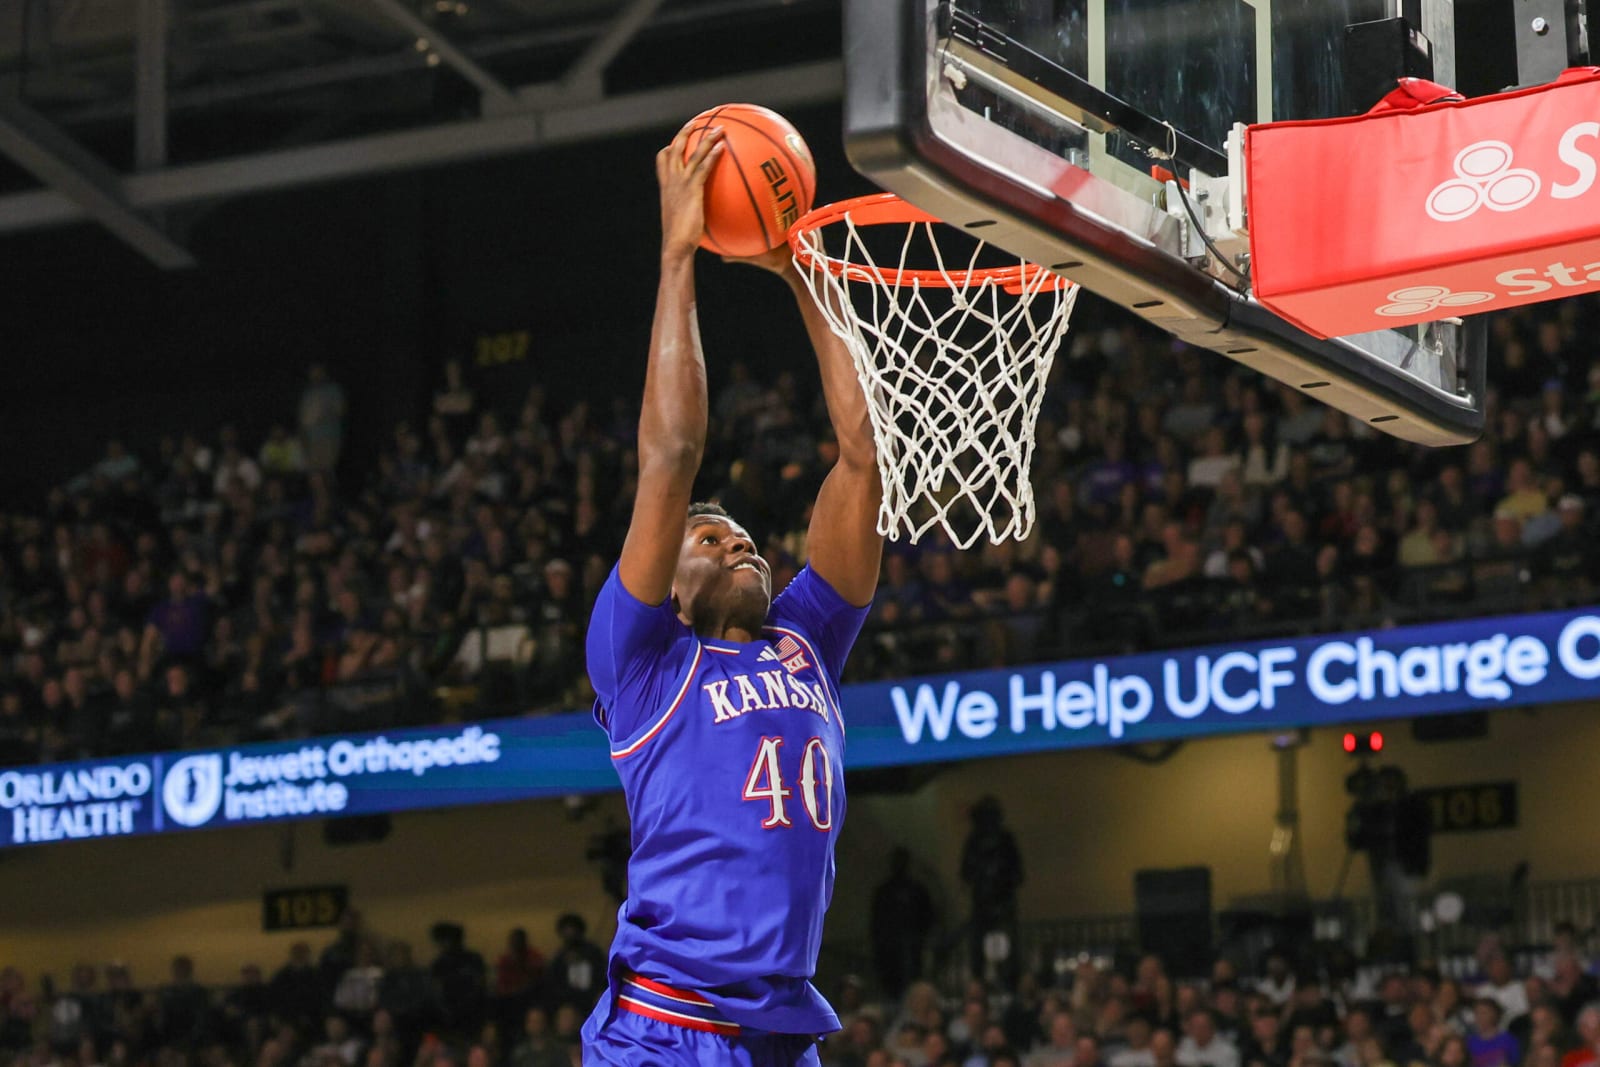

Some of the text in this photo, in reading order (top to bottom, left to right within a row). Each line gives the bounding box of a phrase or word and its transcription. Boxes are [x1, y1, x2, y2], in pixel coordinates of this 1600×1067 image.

[761, 156, 799, 232] ELITE
[891, 681, 998, 744] We
[1009, 664, 1153, 738] Help
[1163, 647, 1297, 719] UCF
[1306, 633, 1549, 704] Charge
[0, 762, 151, 808] ORLANDO
[225, 725, 500, 787] Jewett Orthopedic
[743, 736, 833, 832] 40
[13, 800, 134, 843] HEALTH
[224, 779, 348, 820] Institute
